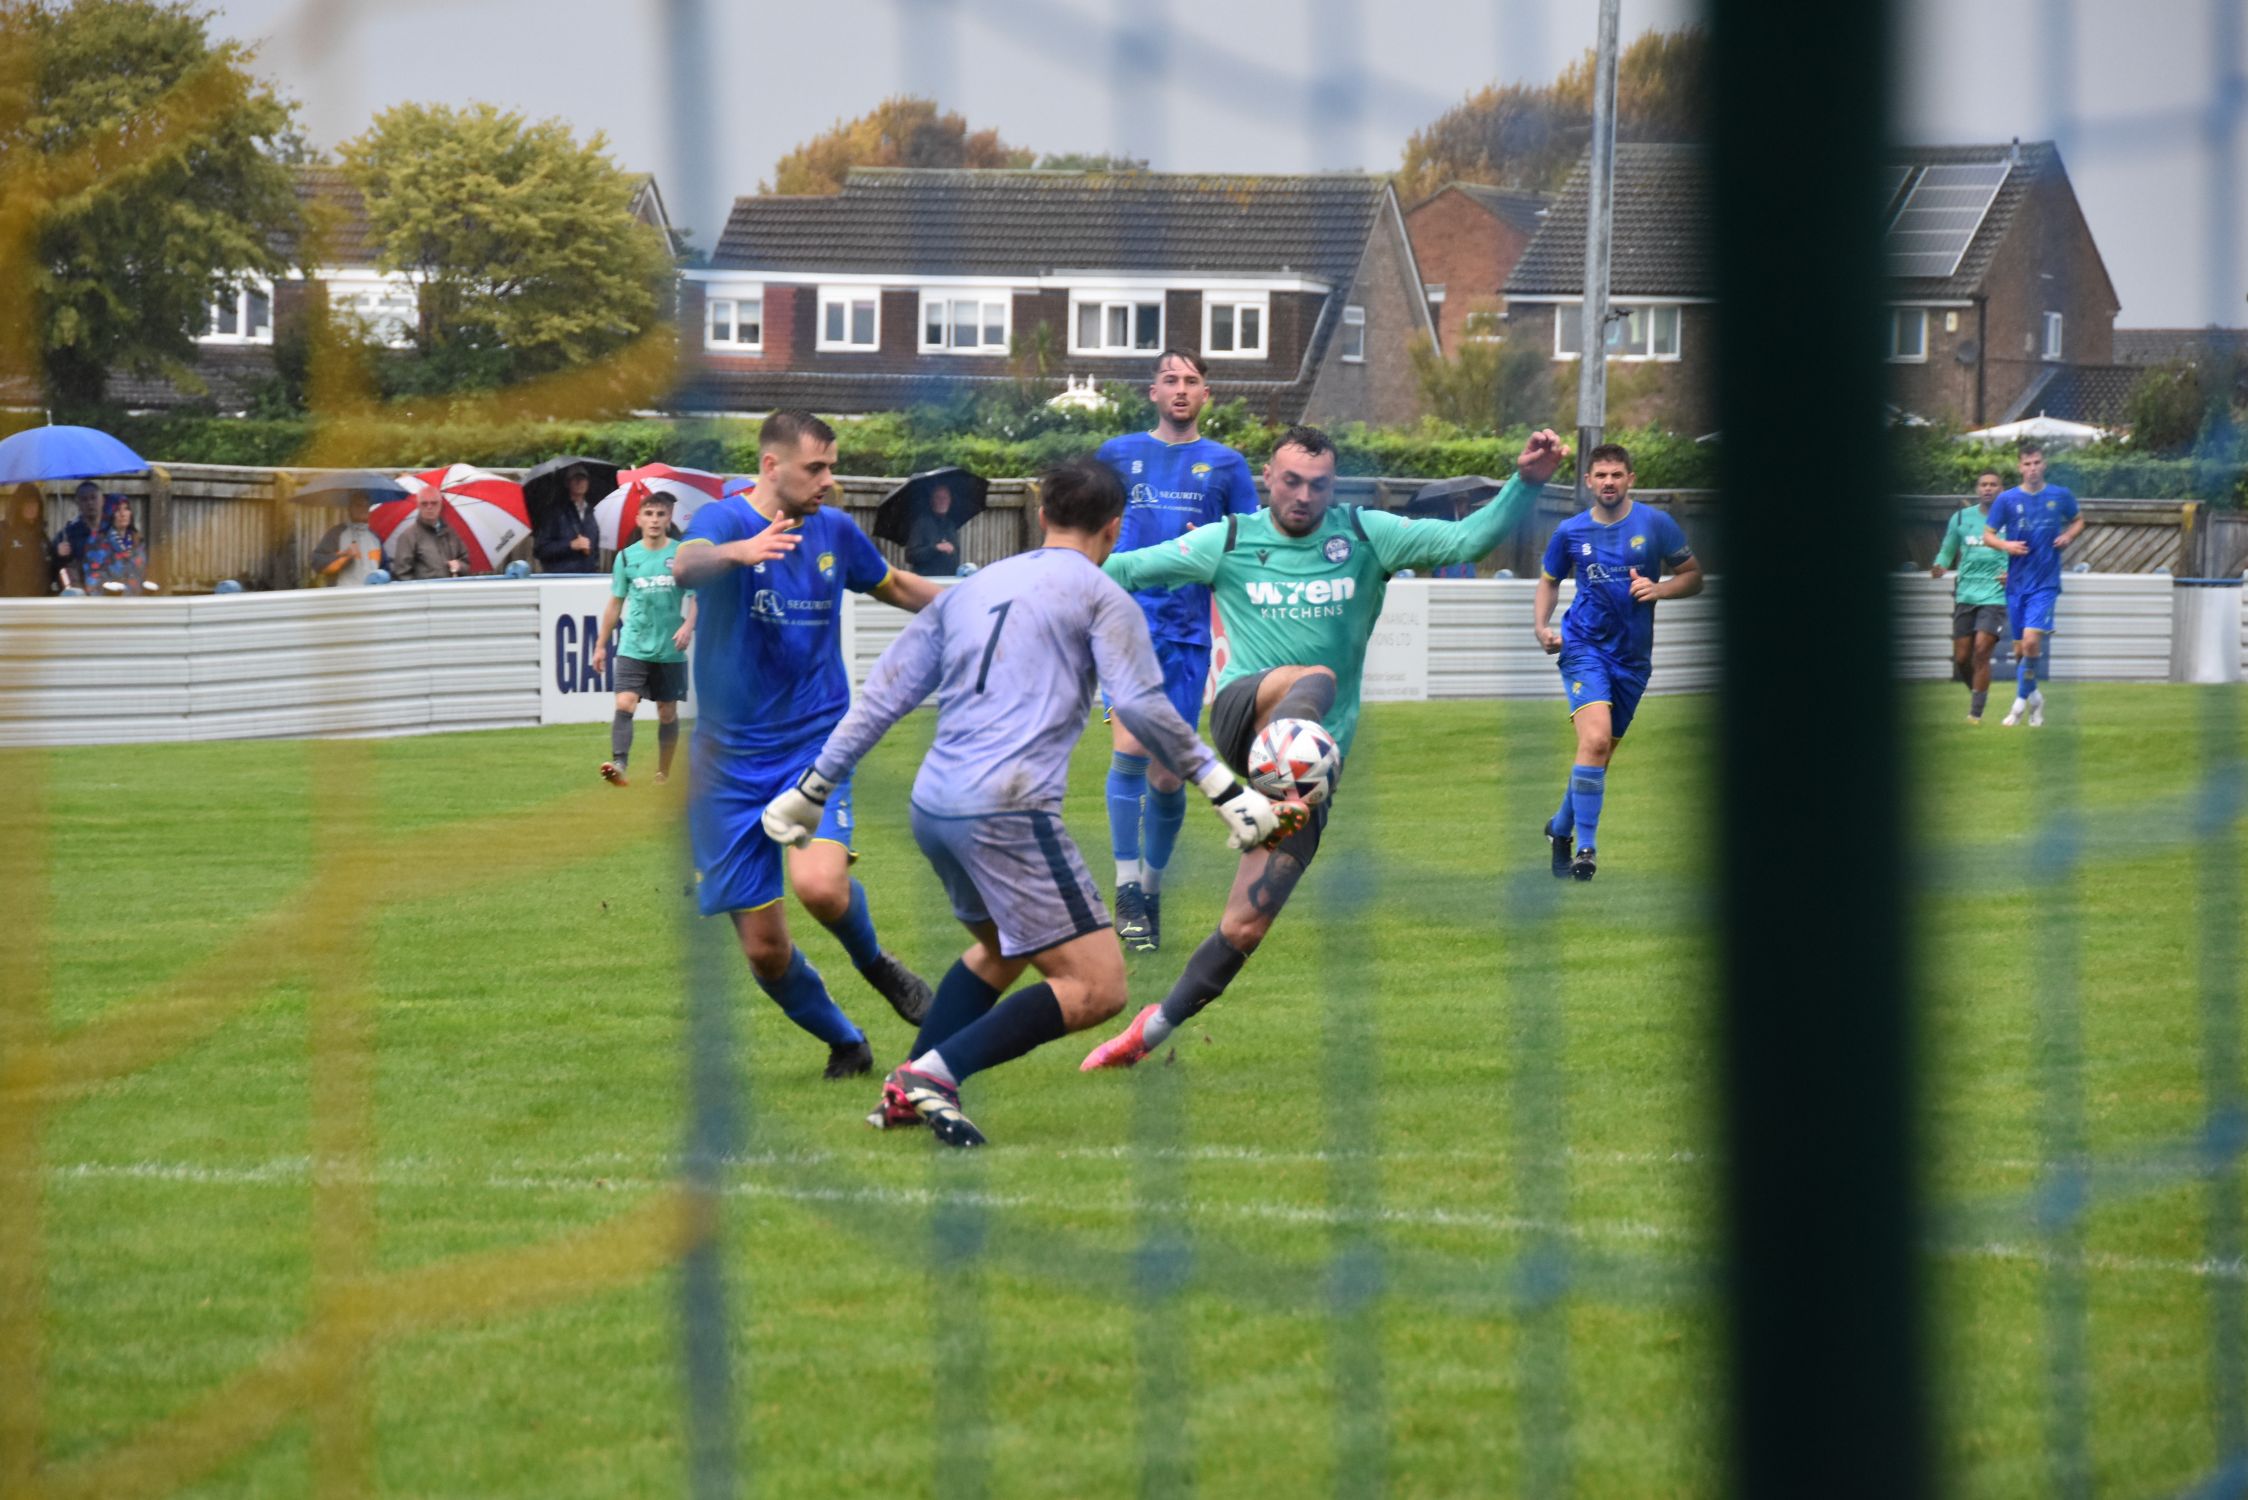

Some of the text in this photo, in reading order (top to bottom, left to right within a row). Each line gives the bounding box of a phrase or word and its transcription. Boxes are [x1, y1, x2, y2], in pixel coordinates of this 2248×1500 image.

[1159, 490, 1205, 501] SECURITY
[1245, 576, 1355, 605] wren
[1261, 604, 1344, 619] KITCHENS
[976, 599, 1013, 695] 1
